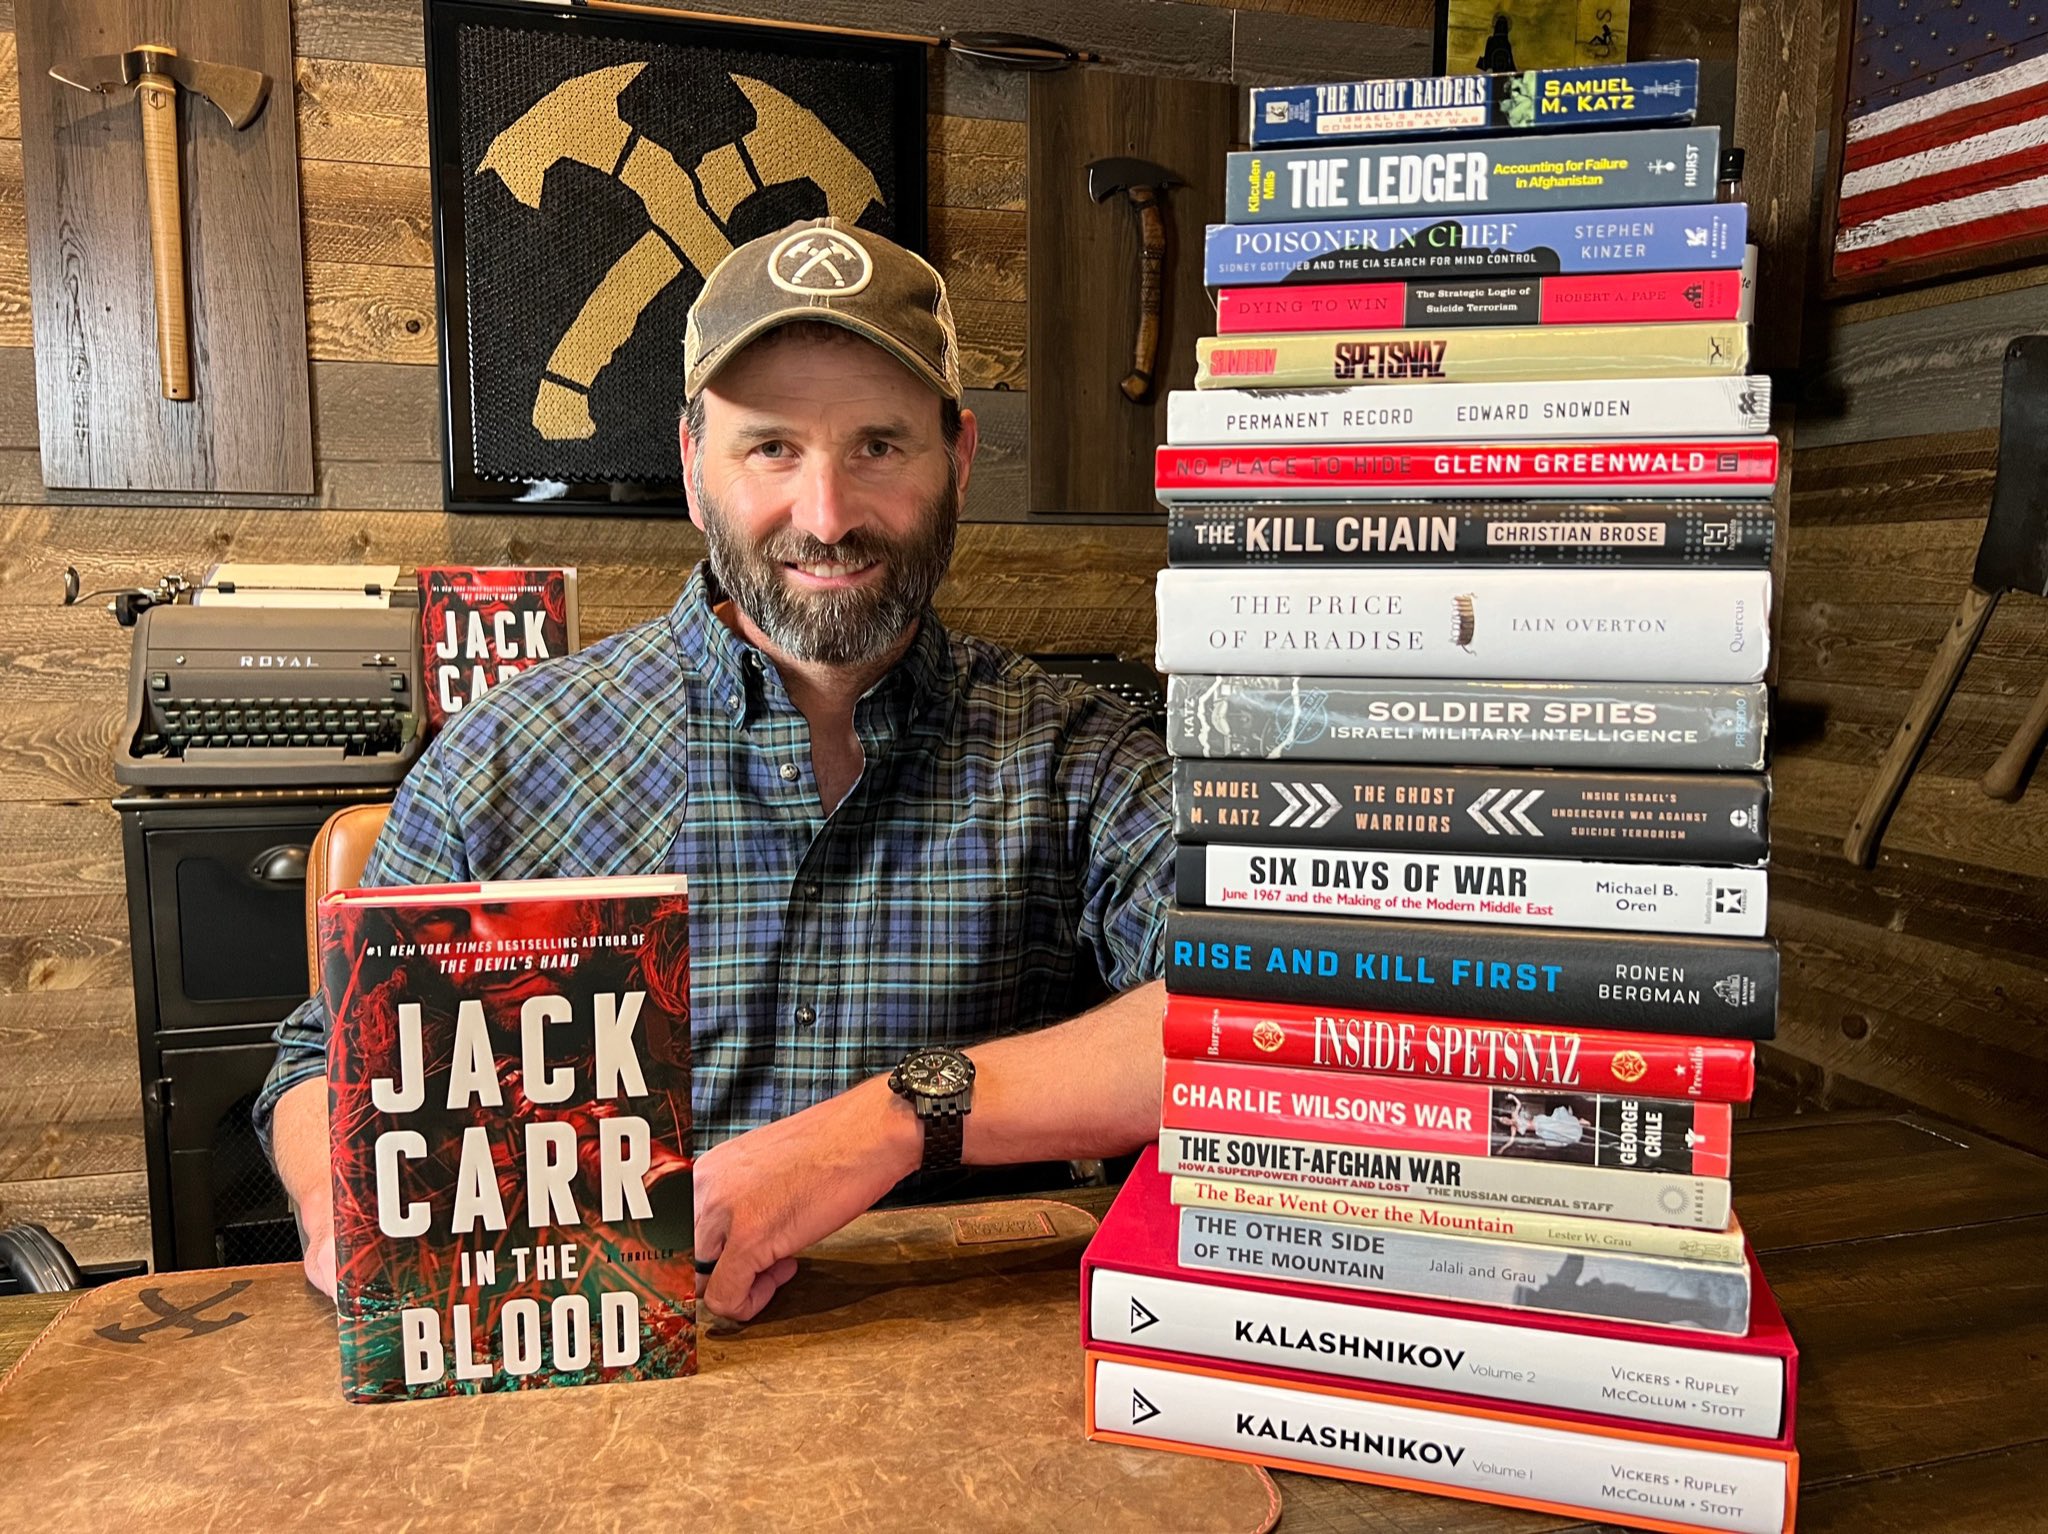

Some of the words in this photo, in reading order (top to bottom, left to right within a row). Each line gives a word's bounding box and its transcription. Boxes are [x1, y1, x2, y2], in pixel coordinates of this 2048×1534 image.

[1317, 86, 1348, 113] THE
[1354, 81, 1407, 111] NIGHT
[1412, 77, 1486, 108] RAIDERS
[1545, 78, 1634, 97] SAMUEL
[1541, 97, 1568, 114] M.
[1578, 94, 1635, 112] KATZ
[1493, 159, 1564, 176] Accounting
[1565, 158, 1584, 172] for
[1585, 158, 1628, 171] Failure
[1685, 144, 1699, 187] HURST
[1248, 159, 1261, 213] Kilcullen
[1287, 158, 1348, 209] THE
[1358, 152, 1488, 206] LEDGER
[1516, 177, 1529, 189] in
[1530, 174, 1603, 190] Afghanistan
[1235, 228, 1383, 254] POISONER
[1390, 226, 1417, 250] IN
[1428, 222, 1518, 248] CHIEF
[1574, 222, 1655, 239] STEPHEN
[1219, 263, 1257, 273] SIDNEY
[1260, 261, 1310, 272] GOTTLIEB
[1313, 260, 1335, 270] AND
[1339, 259, 1358, 269] THE
[1363, 258, 1380, 268] CIA
[1383, 256, 1426, 268] SEARCH
[1430, 256, 1450, 266] FOR
[1455, 255, 1483, 266] MIND
[1487, 253, 1537, 265] CONTROL
[1581, 244, 1647, 259] KINZER
[1416, 290, 1435, 298] The
[1437, 287, 1484, 299] Strategic
[1487, 286, 1516, 298] Logic
[1519, 286, 1531, 296] of
[1426, 303, 1463, 313] Suicide
[1466, 302, 1518, 313] Terrorism
[1334, 340, 1447, 379] SPETSNAZ
[1227, 411, 1329, 430] PERMANENT
[1343, 408, 1414, 426] RECORD
[1457, 403, 1528, 422] EDWARD
[1543, 400, 1630, 418] SNOWDEN
[1177, 458, 1208, 476] NO
[1220, 456, 1297, 476] PLACE
[1311, 456, 1341, 475] TO
[1354, 455, 1413, 474] HIDE
[1434, 454, 1521, 474] GLENN
[1534, 452, 1705, 473] GREENWALD
[1195, 525, 1236, 545] THE
[1246, 517, 1324, 552] KILL
[1335, 516, 1457, 552] CHAIN
[1494, 525, 1592, 542] CHRISTIAN
[1600, 525, 1659, 542] BROSE
[1231, 596, 1290, 615] THE
[1309, 595, 1403, 615] PRICE
[436, 610, 550, 659] JACK
[1512, 618, 1556, 632] IAIN
[1566, 618, 1667, 633] OVERTON
[1729, 599, 1744, 654] Quercus
[1209, 629, 1248, 650] OF
[1264, 630, 1424, 651] PARADISE
[240, 655, 319, 668] ROYAL
[1184, 697, 1196, 738] KATZ
[1367, 702, 1531, 724] SOLDIER
[1543, 702, 1657, 725] SPIES
[1330, 725, 1414, 740] ISRAELI
[1422, 727, 1524, 742] MILITARY
[1531, 728, 1698, 744] INTELLIGENCE
[1193, 781, 1260, 800] SAMUEL
[1354, 785, 1386, 803] THE
[1395, 786, 1455, 806] GHOST
[1190, 806, 1209, 825] M.
[1218, 808, 1260, 827] KATZ
[1355, 813, 1451, 833] WARRIORS
[1552, 808, 1625, 820] UNDERCOVER
[1630, 809, 1654, 821] WAR
[1658, 811, 1708, 823] AGAINST
[1571, 826, 1617, 838] SUICIDE
[1622, 828, 1687, 840] TERRORISM
[1250, 855, 1297, 886] SIX
[1312, 858, 1389, 891] DAYS
[1404, 862, 1440, 893] OF
[1454, 865, 1528, 898] WAR
[1596, 881, 1657, 896] Michael
[1663, 884, 1678, 897] B.
[1221, 887, 1248, 902] June
[1253, 888, 1281, 902] 1967
[1286, 891, 1308, 904] and
[1313, 892, 1333, 904] the
[1337, 894, 1381, 910] Making
[1386, 896, 1399, 908] of
[1402, 897, 1422, 909] the
[1426, 898, 1475, 912] Modern
[1479, 900, 1522, 914] Middle
[1526, 903, 1553, 916] East
[1616, 899, 1657, 913] Oren
[366, 944, 382, 957] #1
[390, 943, 415, 957] NEW
[420, 942, 451, 956] YORK
[455, 941, 493, 954] TIMES
[497, 937, 578, 952] BESTSELLING
[582, 934, 628, 949] AUTHOR
[631, 933, 646, 946] OF
[439, 958, 467, 975] THE
[474, 955, 533, 973] DEVIL'S
[539, 953, 580, 970] HAND
[1174, 940, 1252, 971] RISE
[1266, 947, 1339, 977] AND
[1355, 953, 1435, 984] KILL
[1452, 959, 1563, 993] FIRST
[1616, 963, 1685, 984] RONEN
[1598, 984, 1700, 1006] BERGMAN
[371, 990, 649, 1114] JACK
[1313, 1015, 1415, 1074] INSIDE
[1424, 1024, 1581, 1086] SPETSNAZ
[1172, 1083, 1282, 1115] CHARLIE
[1291, 1093, 1407, 1126] WILSON'S
[1414, 1103, 1472, 1131] WAR
[1620, 1100, 1639, 1166] GEORGE
[1644, 1111, 1663, 1158] CRILE
[1179, 1135, 1221, 1163] THE
[1226, 1140, 1401, 1182] SOVIET-AFGHAN
[1409, 1157, 1461, 1187] WAR
[374, 1115, 653, 1238] CARR
[1178, 1161, 1205, 1173] HOW
[1207, 1164, 1216, 1174] A
[1217, 1165, 1298, 1182] SUPERPOWER
[1301, 1175, 1348, 1188] FOUGHT
[1350, 1178, 1376, 1190] AND
[1379, 1181, 1410, 1193] LOST
[1194, 1182, 1228, 1201] The
[1235, 1187, 1274, 1208] Bear
[1279, 1193, 1328, 1214] Went
[1332, 1199, 1379, 1219] Over
[1384, 1203, 1414, 1223] the
[1419, 1208, 1515, 1235] Mountain
[1195, 1214, 1237, 1237] THE
[1246, 1221, 1322, 1248] OTHER
[1331, 1231, 1385, 1255] SIDE
[461, 1250, 496, 1287] IN
[511, 1244, 579, 1282] THE
[1194, 1242, 1220, 1260] OF
[1227, 1246, 1263, 1265] THE
[1271, 1252, 1384, 1280] MOUNTAIN
[1428, 1257, 1463, 1276] Jalali
[1468, 1263, 1496, 1280] and
[1501, 1268, 1536, 1285] Grau
[401, 1291, 641, 1385] BLOOD
[1235, 1319, 1465, 1372] KALASHNIKOV
[1468, 1362, 1523, 1383] Volume
[1526, 1370, 1536, 1384] 2
[1236, 1413, 1465, 1467] KALASHNIKOV
